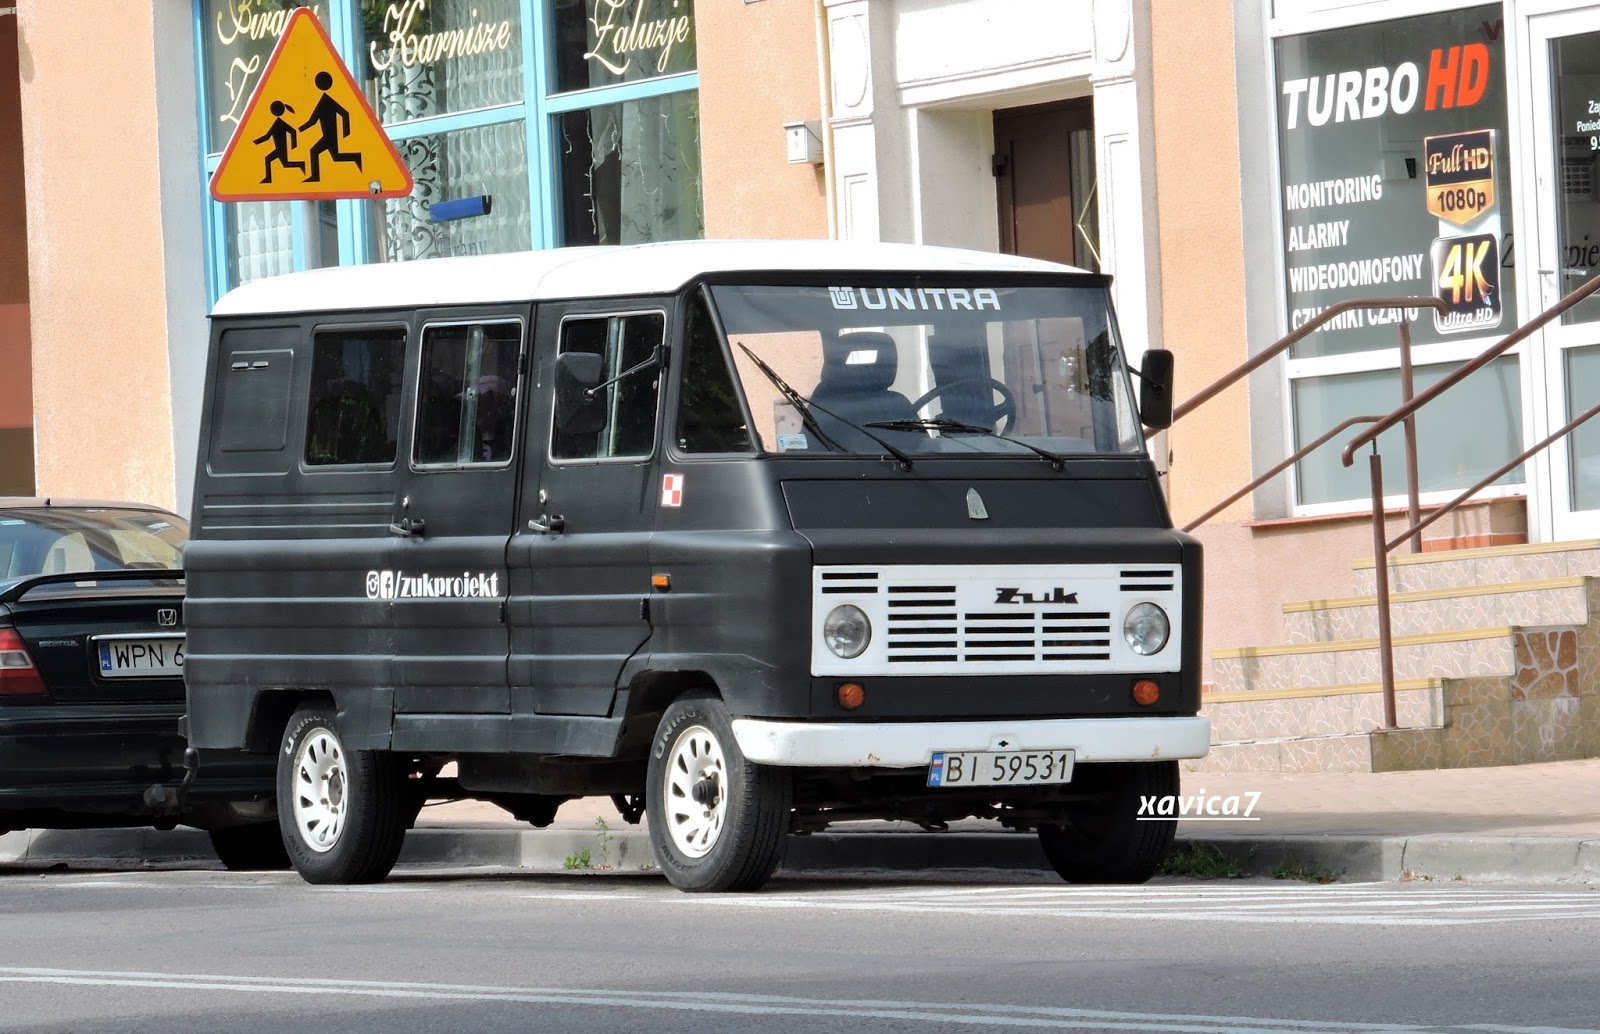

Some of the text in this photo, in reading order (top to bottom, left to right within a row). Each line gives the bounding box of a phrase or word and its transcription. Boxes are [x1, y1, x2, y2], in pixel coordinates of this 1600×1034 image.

[370, 0, 510, 70] Karnisze
[1283, 43, 1491, 130] TURBO HD
[1428, 144, 1490, 174] Full HD
[1286, 174, 1382, 210] MONITORING
[1437, 187, 1487, 213] 1080p
[1288, 220, 1350, 252] ALARMY
[1289, 254, 1424, 293] WIDEODOMOFONY
[1439, 240, 1494, 305] 4K
[860, 288, 1001, 310] UNITRA
[1476, 307, 1493, 323] HD
[102, 643, 184, 669] PL WPN 6
[930, 772, 940, 782] PL
[992, 753, 1067, 782] 59531
